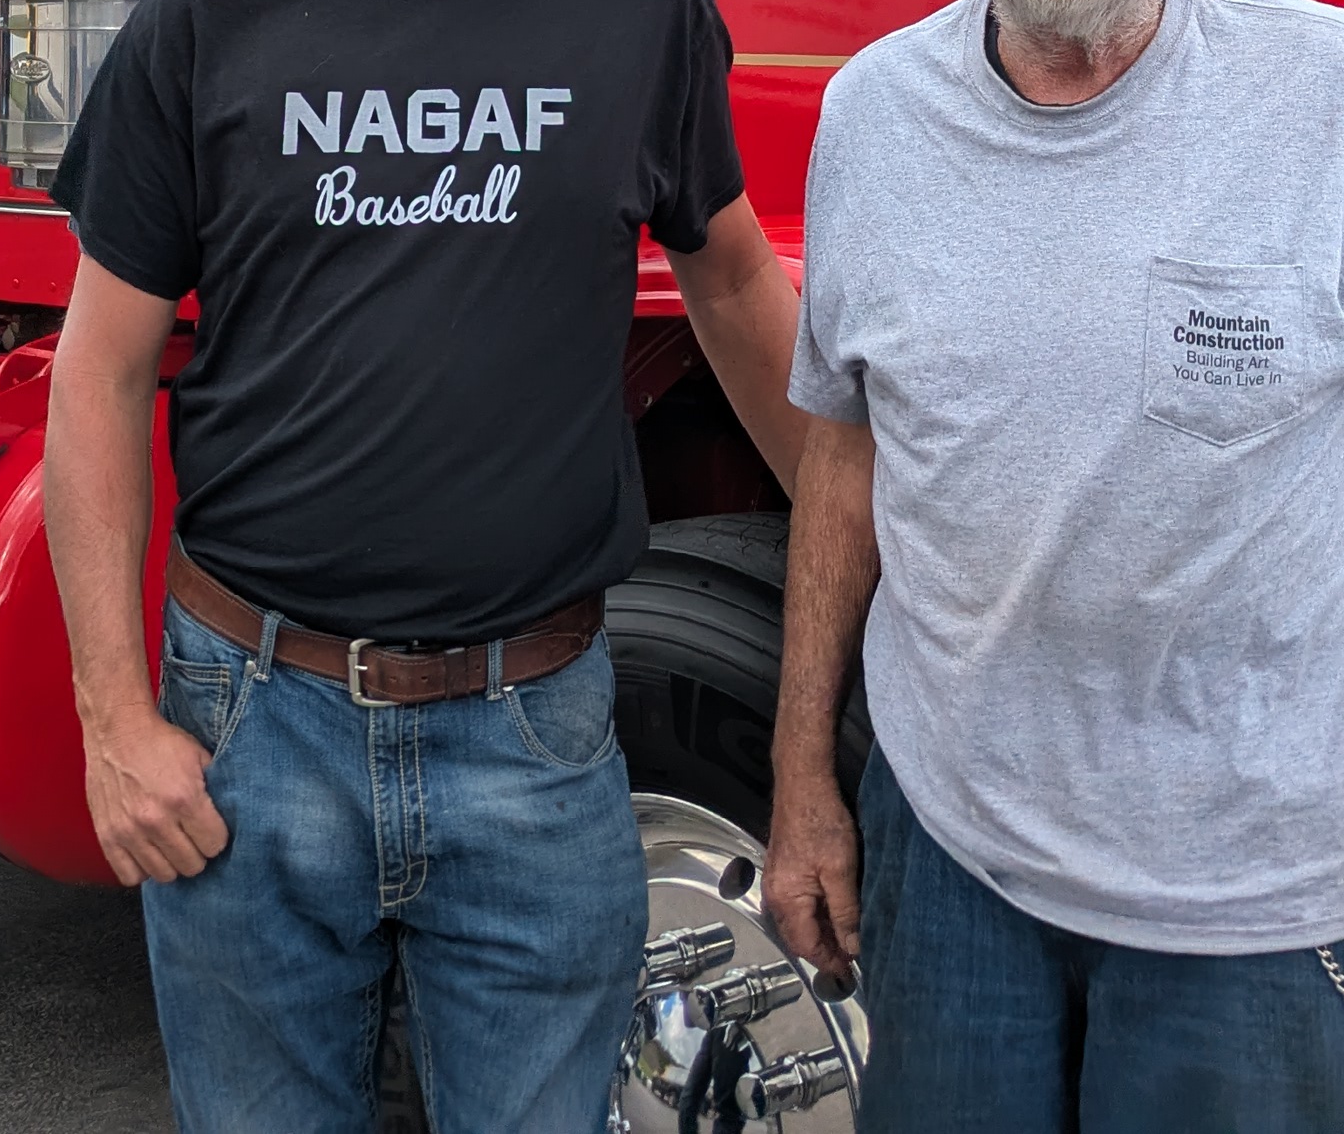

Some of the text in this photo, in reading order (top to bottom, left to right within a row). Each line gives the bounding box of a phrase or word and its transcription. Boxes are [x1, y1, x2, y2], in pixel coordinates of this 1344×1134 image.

[282, 87, 573, 156] NAGAF
[315, 163, 522, 227] Baseball
[1188, 309, 1271, 333] Mountain
[1173, 325, 1284, 351] Construction
[1186, 350, 1270, 372] Building Art
[1173, 364, 1282, 387] You Can Live In
